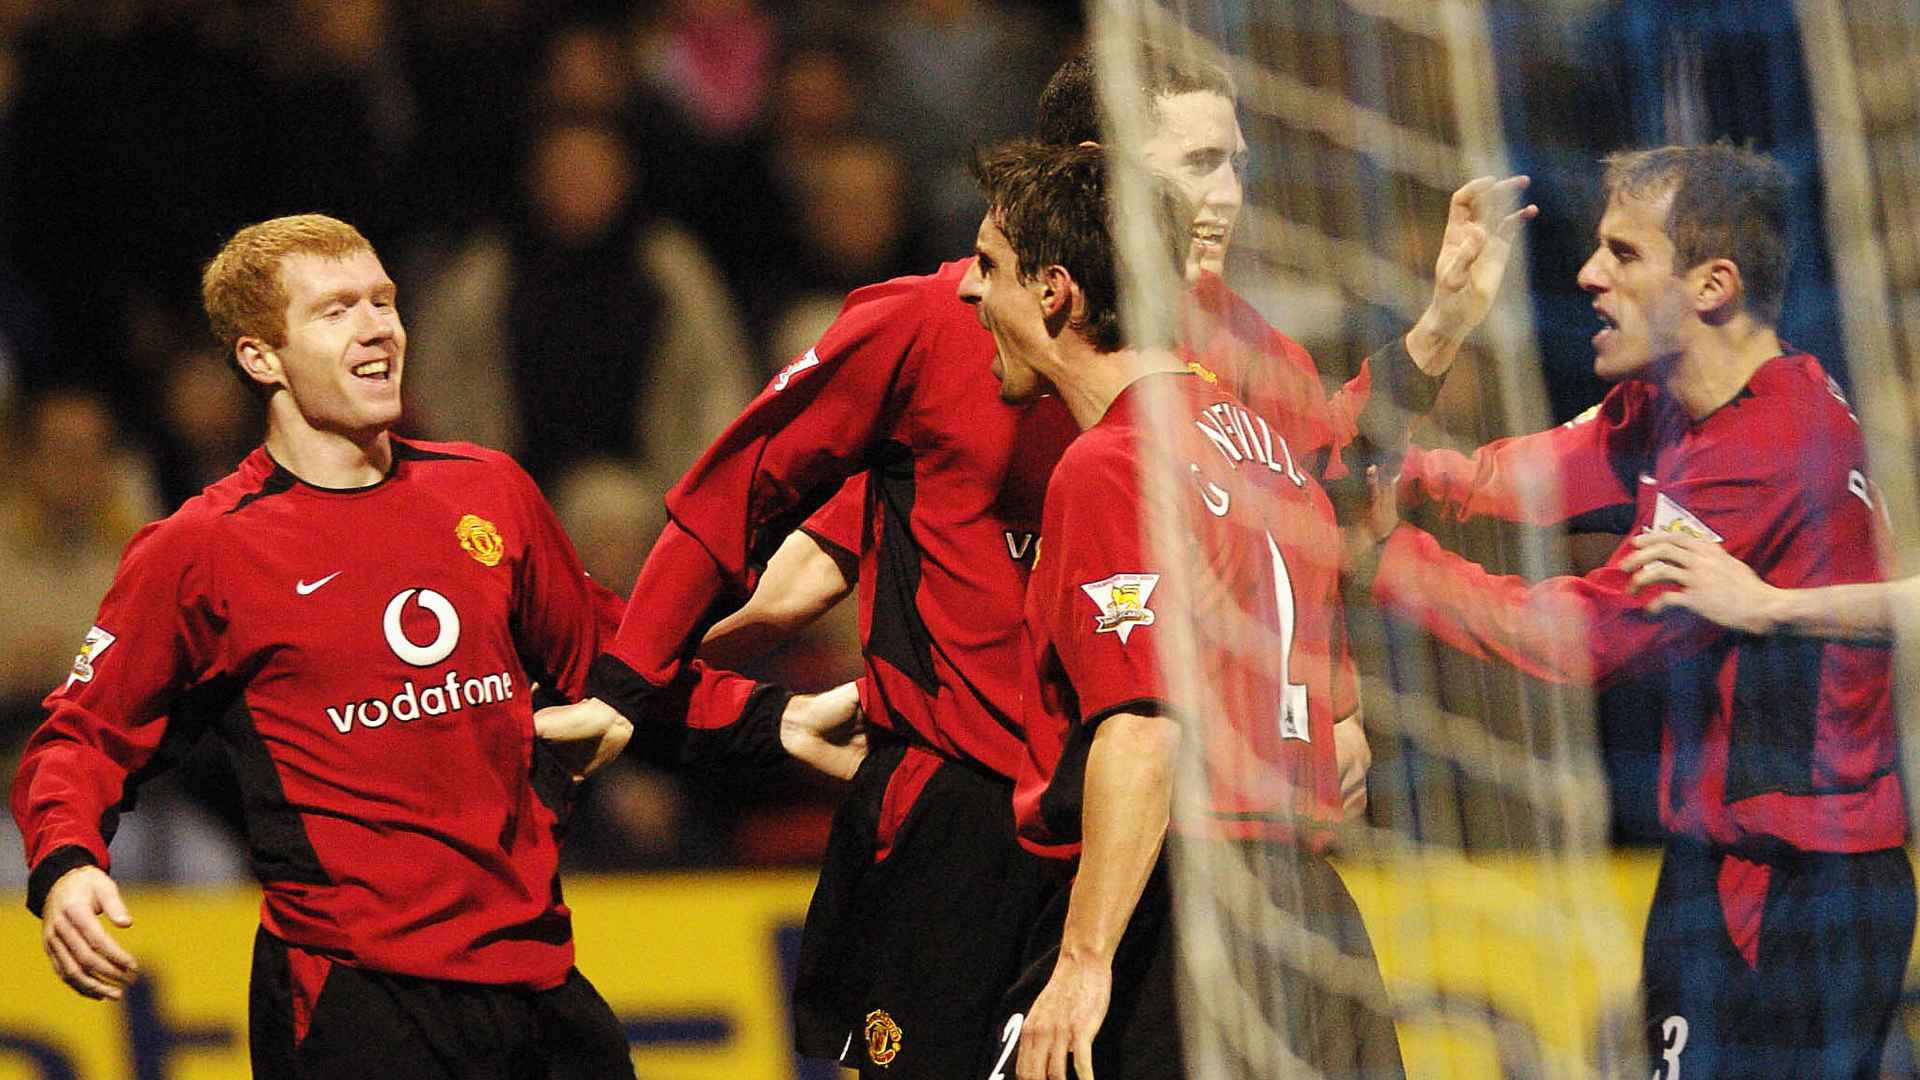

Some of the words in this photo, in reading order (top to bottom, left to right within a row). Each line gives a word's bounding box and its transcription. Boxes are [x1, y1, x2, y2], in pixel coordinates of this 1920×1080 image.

[1194, 402, 1307, 487] NEVILL
[325, 670, 513, 734] vodafone
[1652, 1015, 1690, 1080] 3
